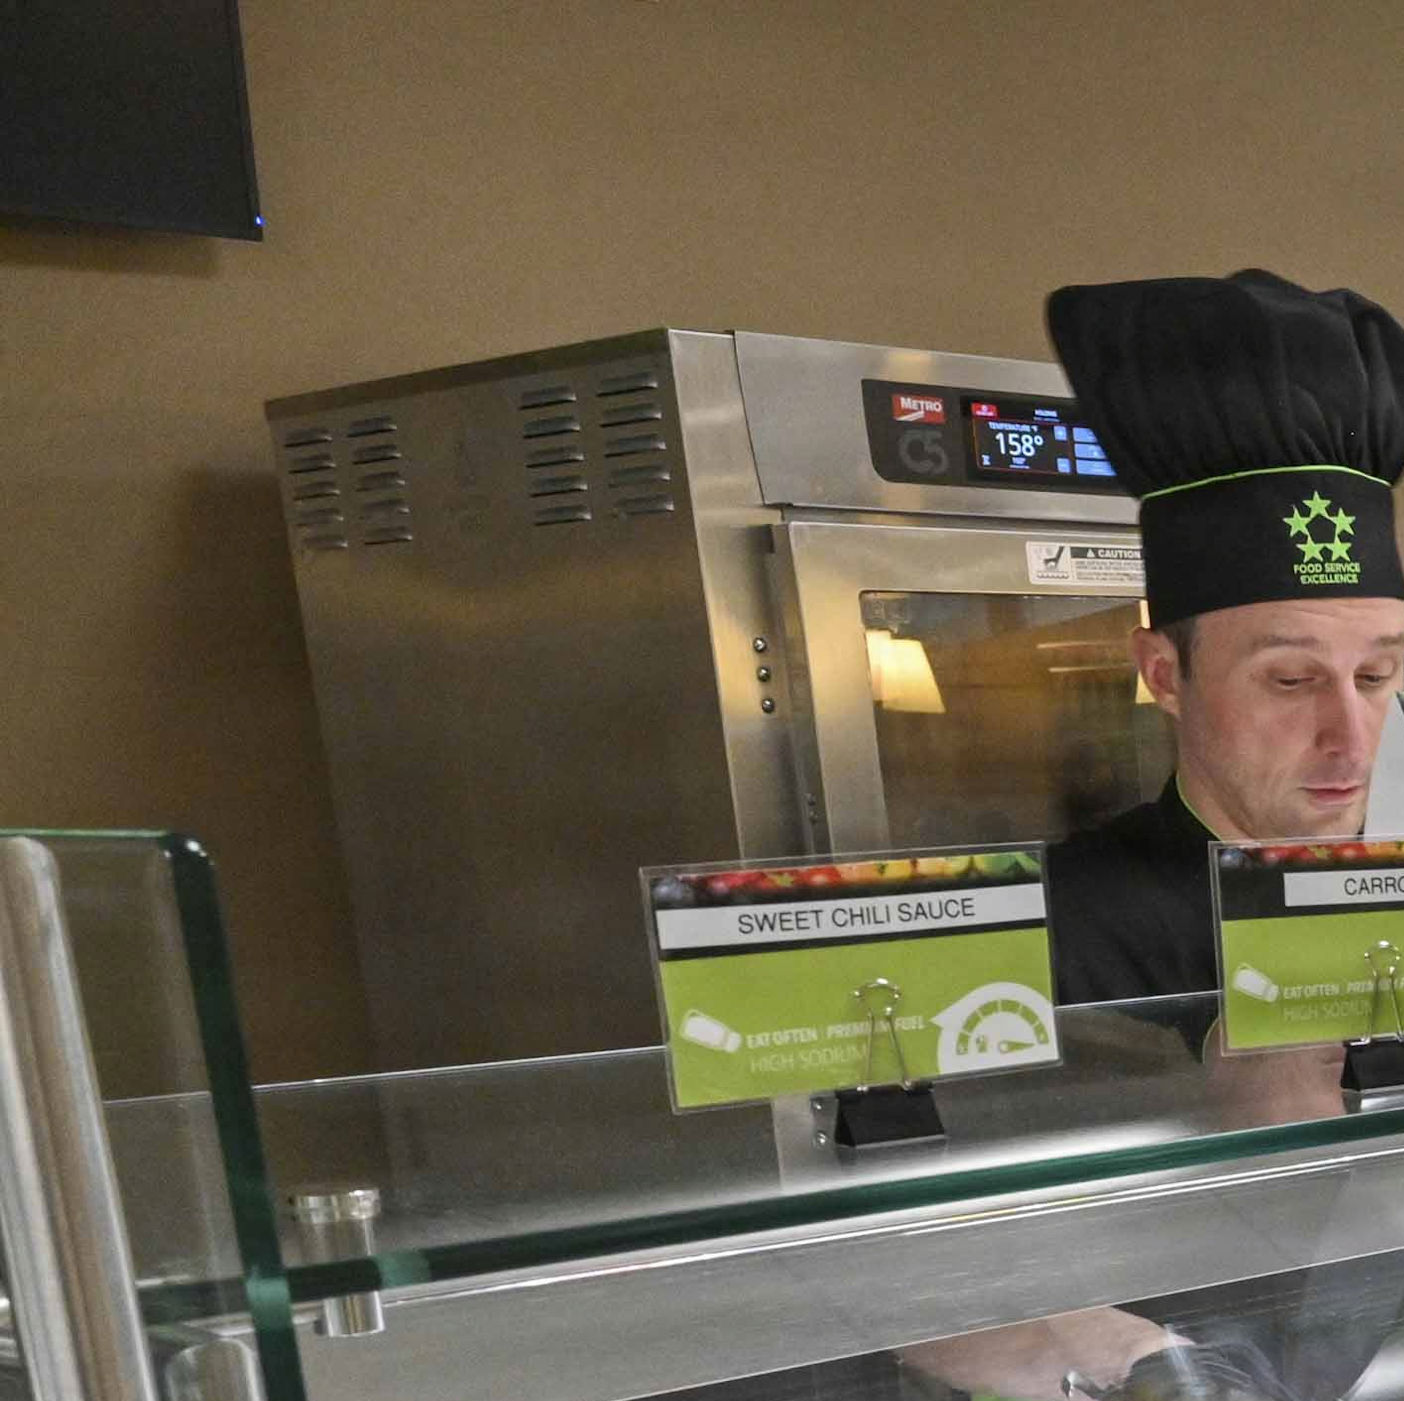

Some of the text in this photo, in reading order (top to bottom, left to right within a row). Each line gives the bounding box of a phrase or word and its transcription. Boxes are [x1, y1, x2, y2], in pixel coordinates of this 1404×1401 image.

[1098, 549, 1141, 559] CAUTION
[1293, 562, 1361, 574] FOOD SERVICE
[1300, 573, 1359, 585] EXCELLENCE
[737, 897, 976, 935] SWEET CHILI SAUCE
[745, 1032, 770, 1049] EAT
[772, 1026, 818, 1046] OFTEN
[894, 1014, 925, 1031] FUEL
[750, 1053, 795, 1073] HIGH
